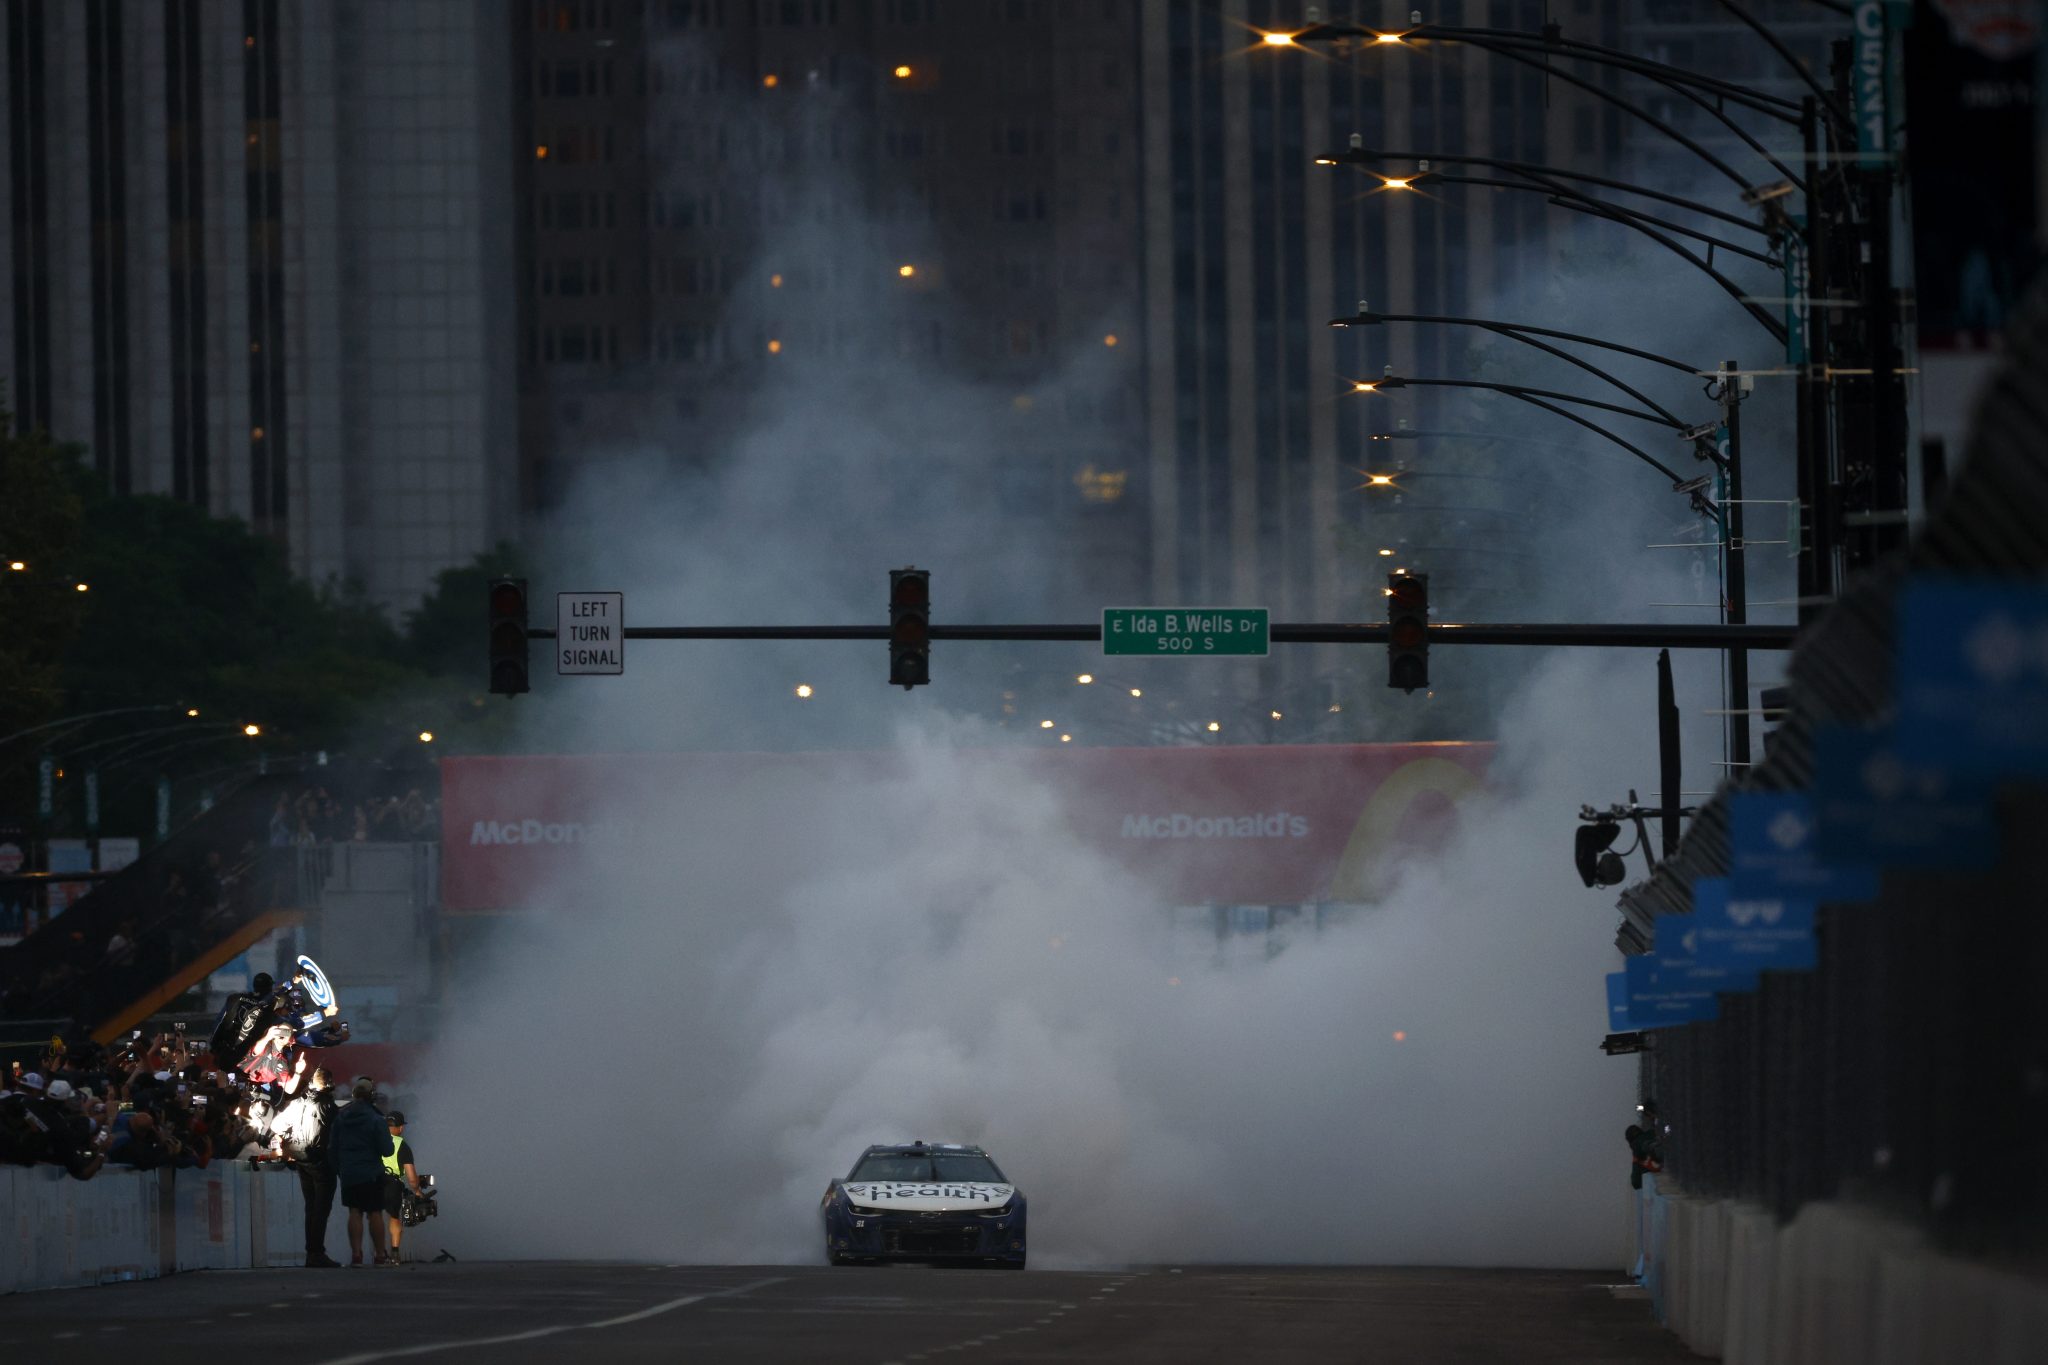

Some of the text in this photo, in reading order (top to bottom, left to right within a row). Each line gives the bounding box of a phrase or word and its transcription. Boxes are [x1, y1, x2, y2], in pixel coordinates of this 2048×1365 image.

[572, 602, 608, 617] LEFT
[1112, 614, 1259, 633] E Ida B. Wells Dr
[570, 626, 610, 641] TURN
[1158, 637, 1215, 650] 500 S
[563, 650, 618, 665] SIGNAL
[1120, 812, 1309, 837] McDonald's
[470, 819, 598, 847] McDon
[871, 1188, 990, 1203] health
